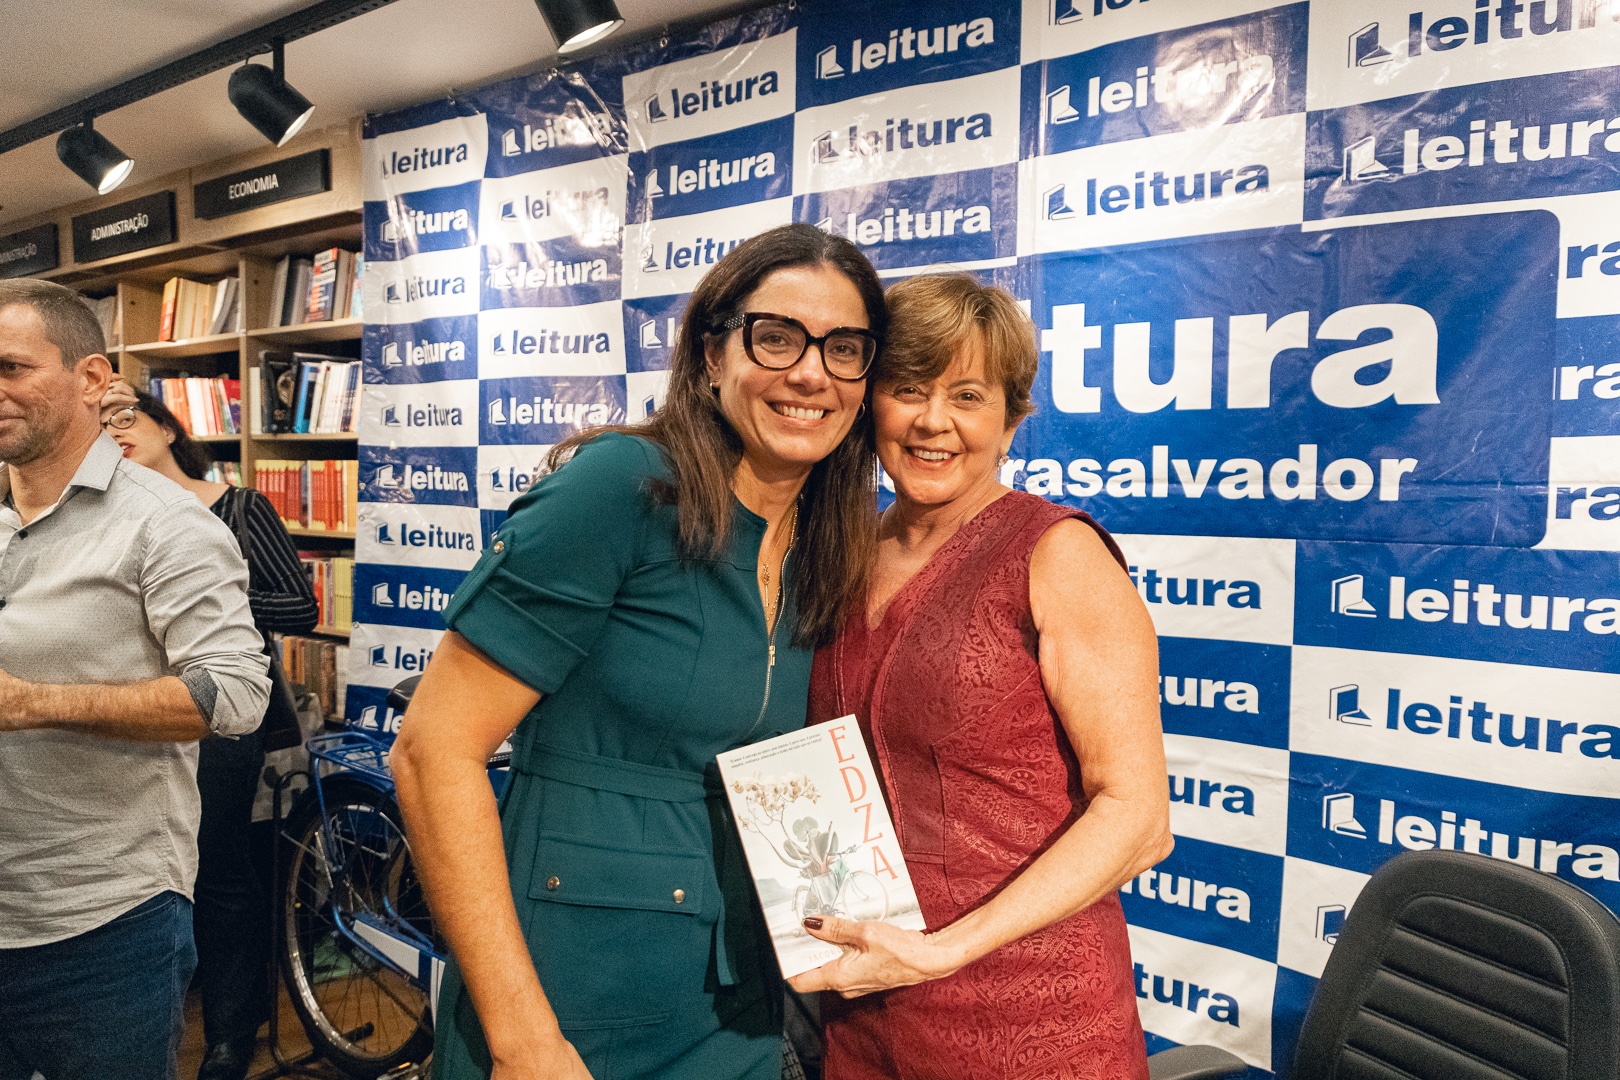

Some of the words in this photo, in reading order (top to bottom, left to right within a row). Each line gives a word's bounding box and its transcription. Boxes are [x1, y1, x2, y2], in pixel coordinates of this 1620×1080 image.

[852, 17, 995, 74] leitura
[671, 70, 779, 118] leitura
[391, 142, 468, 175] leitura
[668, 151, 776, 195] leitura
[228, 173, 279, 200] ECONOMIA
[1087, 164, 1270, 216] leitura
[90, 213, 149, 241] ADMINISTRAÇÃO
[847, 205, 992, 246] leitura
[406, 276, 466, 303] leitura
[520, 259, 608, 291] leitura
[405, 340, 466, 367] leitura
[512, 330, 610, 355] leitura
[1041, 302, 1441, 414] tura
[407, 403, 463, 427] leitura
[510, 395, 608, 424] leitura
[404, 464, 469, 493] leitura
[401, 523, 475, 553] leitura
[1386, 687, 1620, 760] leitura
[828, 725, 899, 880] EDZA
